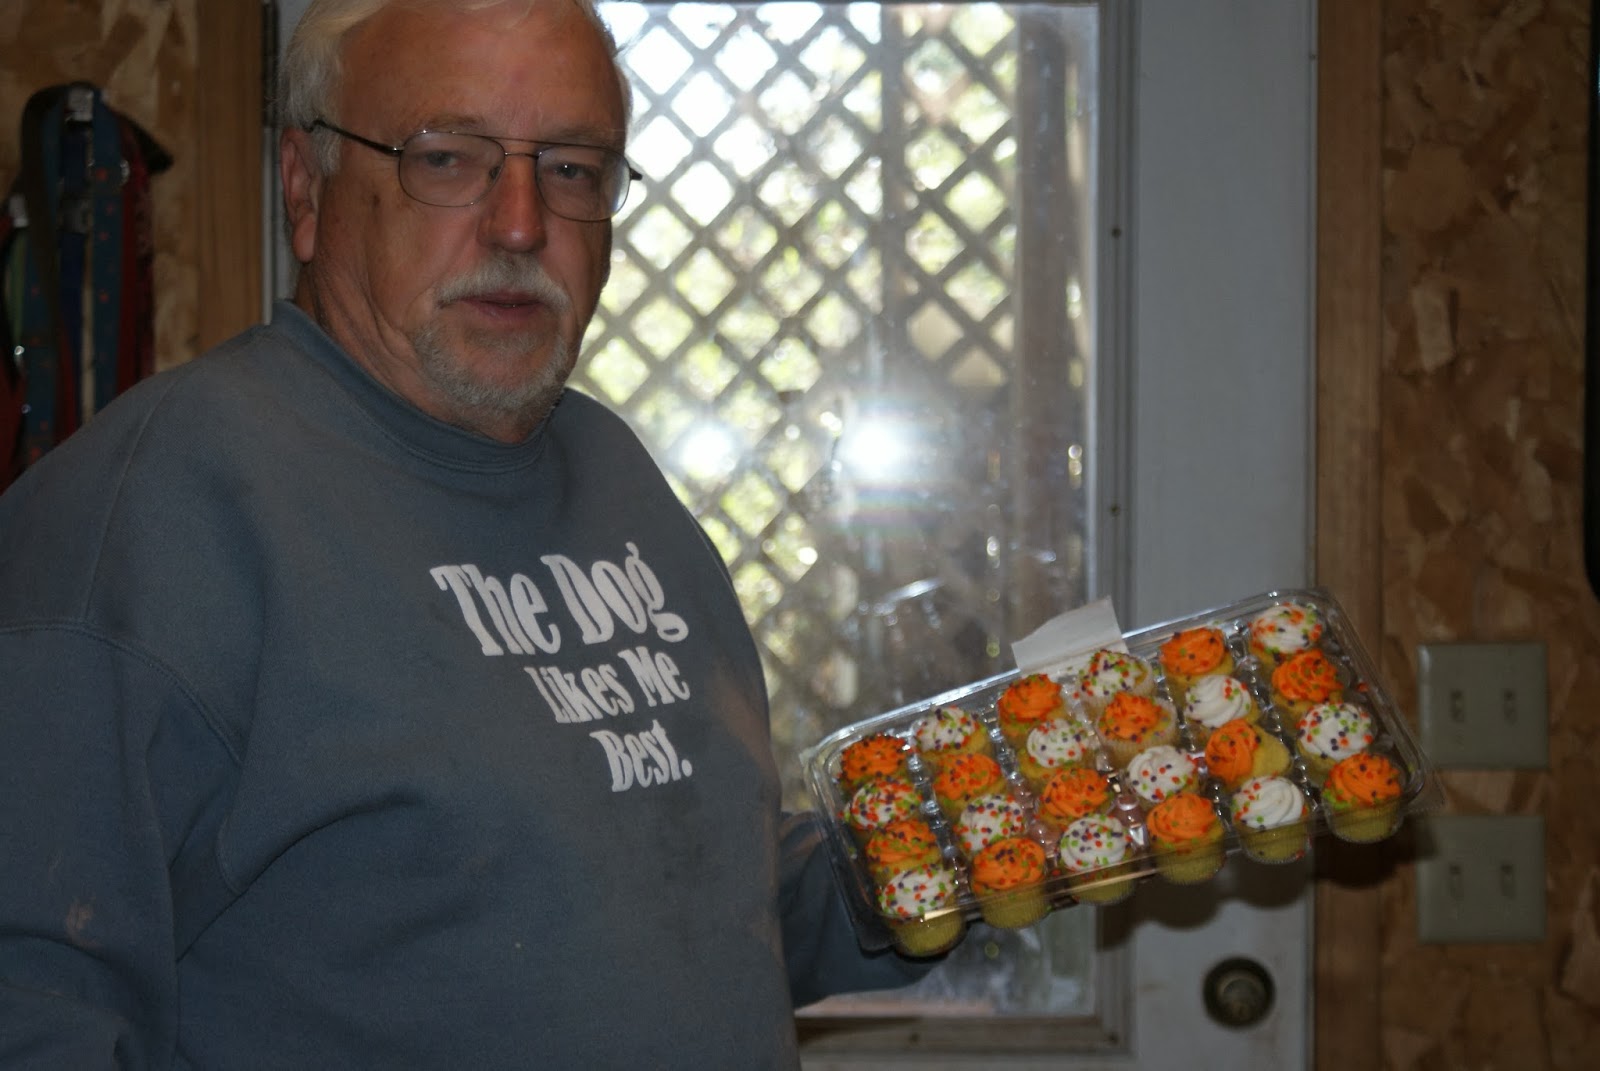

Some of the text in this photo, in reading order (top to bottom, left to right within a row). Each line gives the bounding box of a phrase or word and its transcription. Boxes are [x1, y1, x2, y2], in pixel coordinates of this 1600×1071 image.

[429, 541, 690, 656] The Dog
[617, 646, 691, 707] Me
[589, 719, 693, 792] Best.
